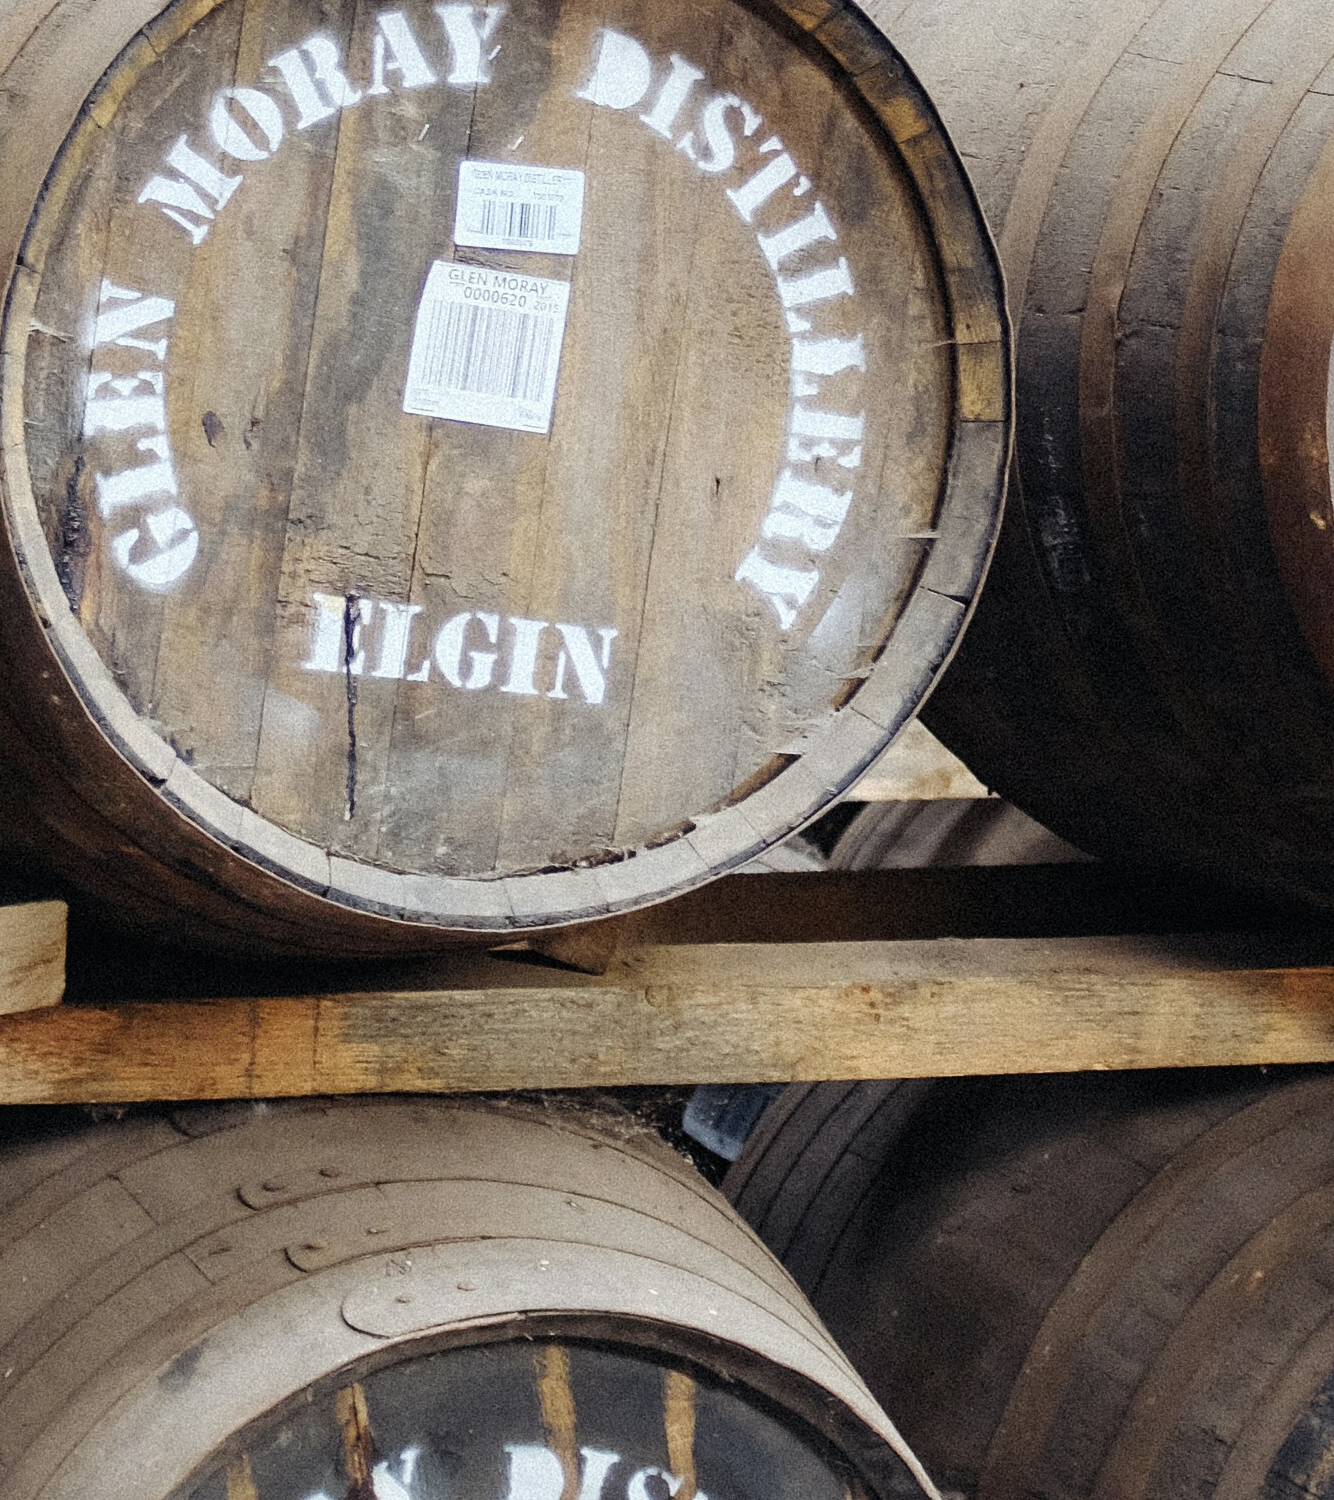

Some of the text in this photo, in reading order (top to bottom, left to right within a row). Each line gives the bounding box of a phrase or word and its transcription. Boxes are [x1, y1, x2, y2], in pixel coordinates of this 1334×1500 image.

[79, 2, 866, 631] GLEN MORAY DISTILLERY
[449, 269, 549, 295] GLEN MORAY
[464, 287, 560, 313] 0000620 2015
[300, 591, 619, 705] ELGIN
